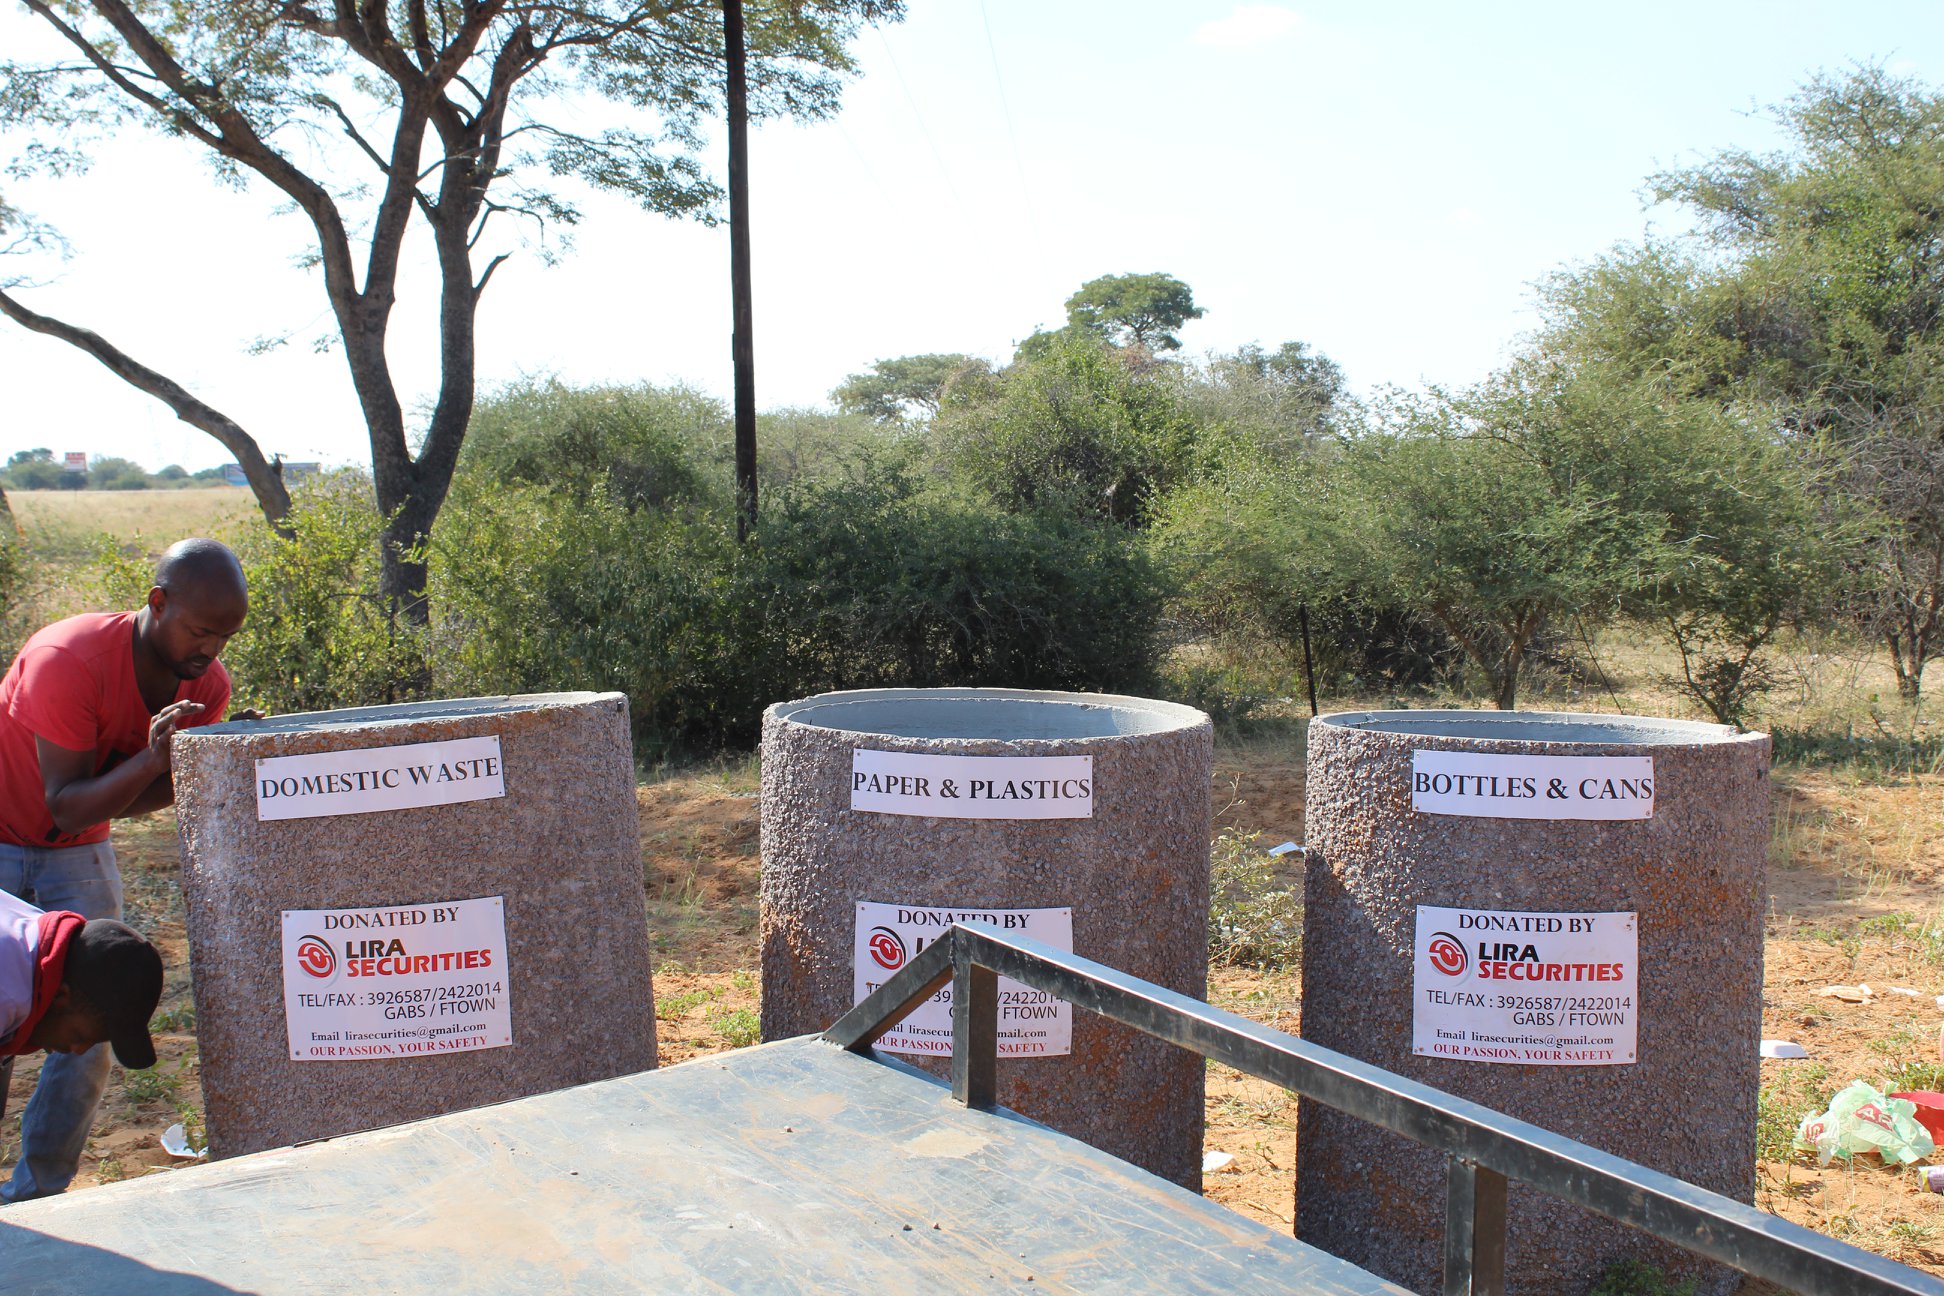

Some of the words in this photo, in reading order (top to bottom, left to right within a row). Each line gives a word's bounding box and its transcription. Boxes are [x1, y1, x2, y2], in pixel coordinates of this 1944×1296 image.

[261, 768, 399, 798] DOMESTIC
[406, 757, 499, 786] WASTE
[853, 772, 931, 797] PAPER
[939, 778, 960, 799] &
[969, 778, 1090, 800] PLASTICS
[1414, 772, 1537, 799] BOTTLES
[1546, 778, 1569, 799] &
[1578, 778, 1652, 799] CANS
[324, 910, 426, 930] DONATED
[432, 907, 460, 923] BY
[1003, 914, 1030, 928] BY
[1458, 913, 1562, 933] DONATED
[1569, 918, 1595, 933] BY
[346, 938, 406, 959] LIRA
[1478, 942, 1540, 962] LIRA
[347, 949, 492, 978] SECURITIES
[1478, 961, 1624, 982] SECURITIES
[368, 981, 501, 1006] 3926587/2422014
[1497, 995, 1631, 1011] 3926587/2422014
[384, 1004, 426, 1020] GABS
[440, 997, 496, 1016] FTOWN
[1003, 1005, 1057, 1020] FTOWN
[1513, 1011, 1554, 1026] GABS
[1569, 1012, 1624, 1026] FTOWN
[311, 1031, 340, 1041] Email
[345, 1023, 487, 1041] lirasecurities@gmail.com
[1436, 1029, 1465, 1040] Email
[1471, 1031, 1614, 1048] lirasecurities@gmail.com
[310, 1046, 335, 1056] OUR
[339, 1045, 395, 1056] PASSION,
[398, 1041, 436, 1053] YOUR
[438, 1035, 488, 1050] SAFETY
[998, 1043, 1047, 1053] SAFETY
[1433, 1043, 1460, 1055] OUR
[1463, 1046, 1520, 1060] PASSION,
[1524, 1049, 1562, 1060] YOUR
[1564, 1050, 1614, 1060] SAFETY
